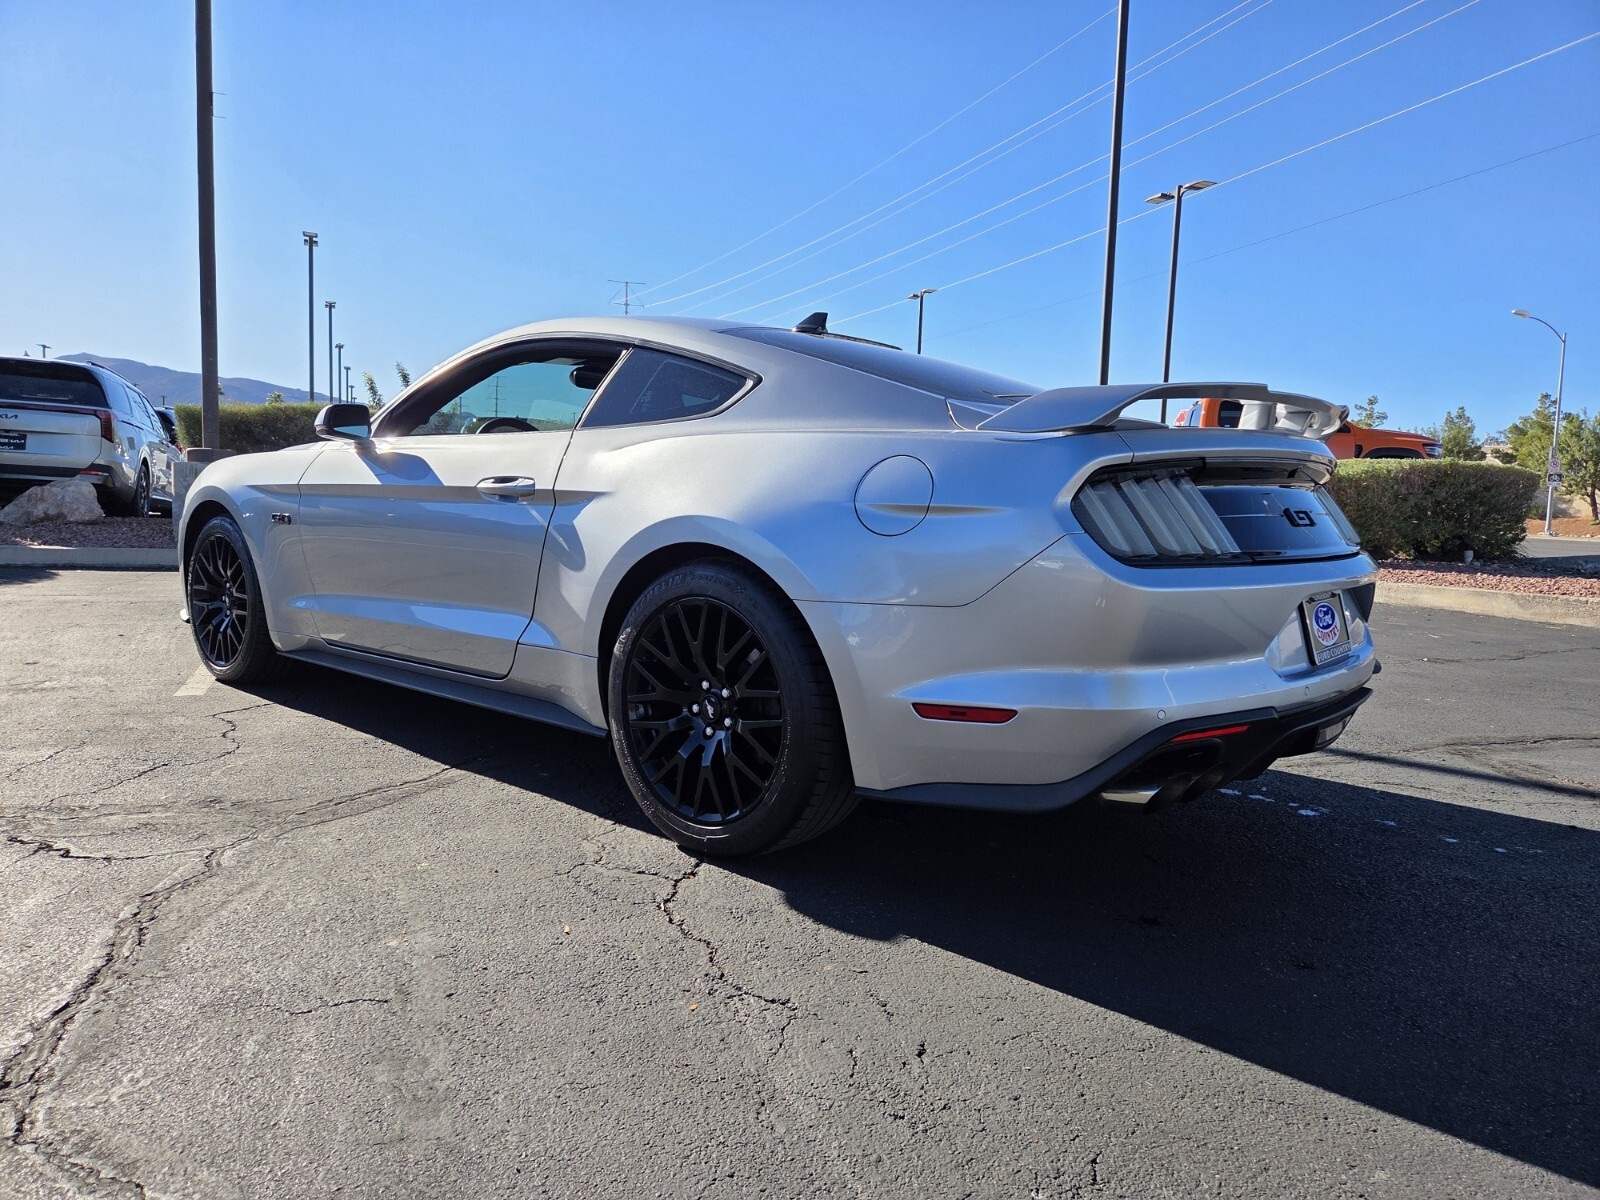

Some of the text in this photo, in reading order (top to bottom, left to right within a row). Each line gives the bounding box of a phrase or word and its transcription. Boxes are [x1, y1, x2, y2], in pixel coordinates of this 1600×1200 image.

[628, 573, 684, 624] MICHELIN
[1317, 607, 1333, 628] Ford
[1316, 624, 1340, 643] COUNTRY
[1317, 642, 1352, 663] FORD COUNTRY
